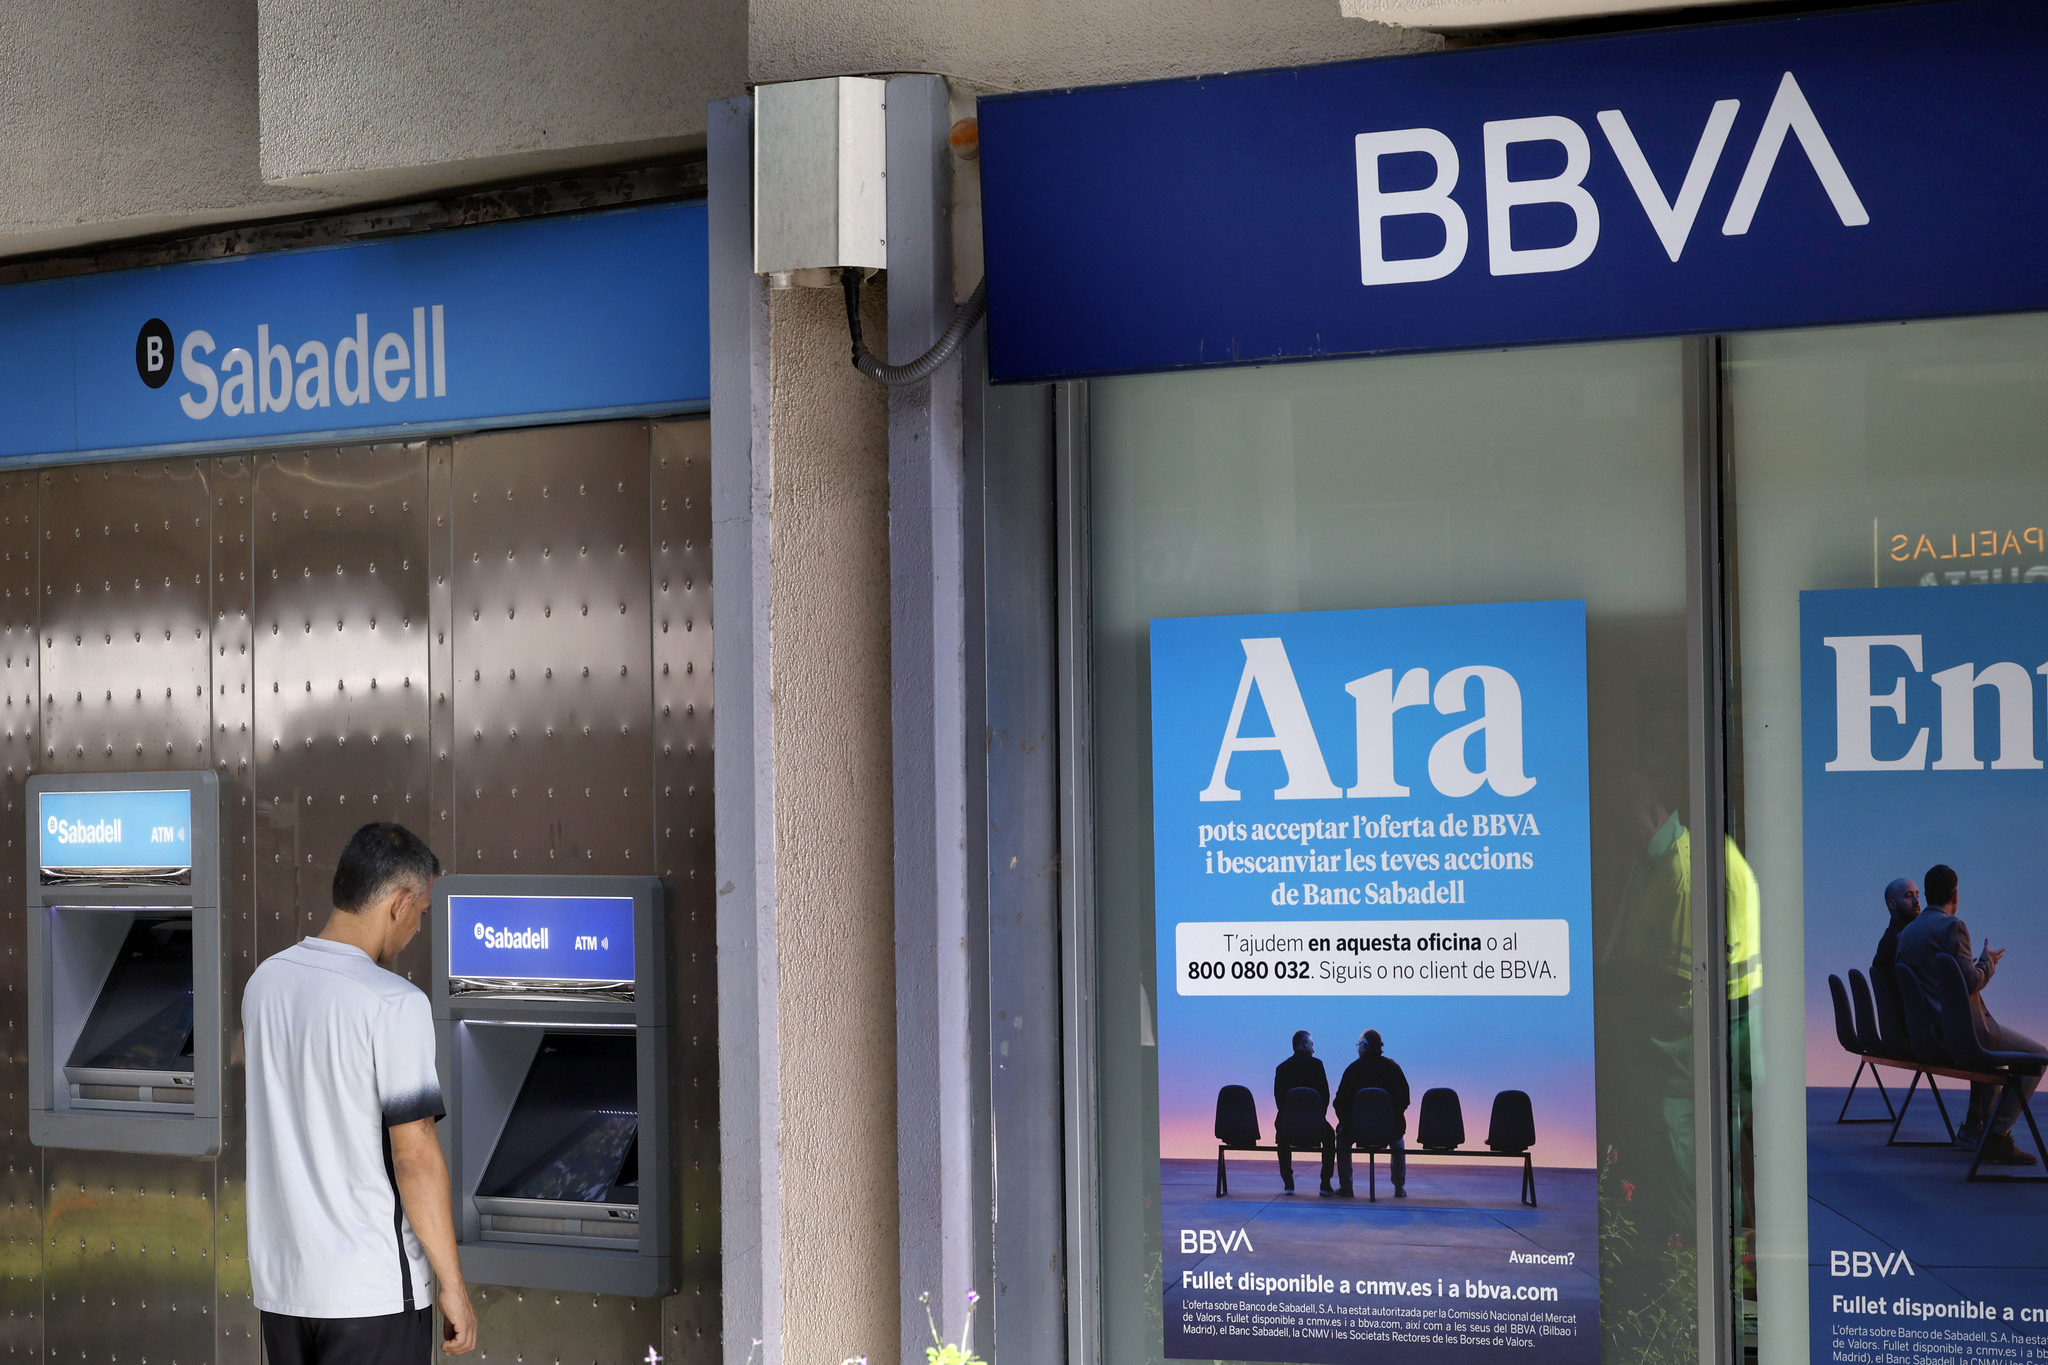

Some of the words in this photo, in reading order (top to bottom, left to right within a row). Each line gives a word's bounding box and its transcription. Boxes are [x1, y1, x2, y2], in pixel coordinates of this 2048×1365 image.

[1355, 71, 1869, 286] BBVA
[180, 305, 446, 420] Sabadell
[1824, 634, 2048, 772] En
[1200, 637, 1537, 802] Ara
[58, 819, 121, 843] Sabadell
[151, 827, 174, 842] ATM
[1199, 821, 1247, 847] pots
[1252, 819, 1349, 845] acceptar
[1439, 814, 1468, 837] de
[1472, 814, 1540, 836] BBVA
[1206, 851, 1213, 873] i
[1217, 849, 1341, 873] bescanviar
[1345, 848, 1376, 871] les
[1381, 851, 1440, 871] teves
[1444, 846, 1533, 870] accions
[1271, 882, 1299, 905] de
[1303, 884, 1361, 905] Banc
[1365, 880, 1465, 904] Sabadell
[485, 927, 548, 949] Sabadell
[575, 936, 597, 950] ATM
[1309, 938, 1330, 951] en
[1337, 934, 1410, 955] aquesta
[1417, 933, 1481, 951] oficina
[1487, 937, 1497, 950] o
[1502, 932, 1518, 951] al
[1189, 962, 1225, 979] 800
[1232, 961, 1268, 979] 080
[1275, 961, 1315, 980] 032.
[1320, 961, 1371, 983] Siguis
[1377, 966, 1387, 979] o
[1394, 966, 1414, 979] no
[1420, 961, 1467, 979] client
[1473, 961, 1494, 979] de
[1501, 961, 1556, 978] BBVA.
[1181, 1228, 1253, 1254] BBVA
[1509, 1250, 1575, 1265] Avancem?
[1831, 1250, 1915, 1278] BBVA
[1183, 1271, 1233, 1289] Fullet
[1238, 1272, 1334, 1295] disponible
[1340, 1280, 1350, 1293] a
[1356, 1281, 1432, 1296] cnmv.es
[1438, 1279, 1442, 1296] i
[1449, 1284, 1459, 1297] a
[1466, 1280, 1557, 1301] bbva.com
[1215, 1301, 1238, 1310] sobre
[1240, 1301, 1266, 1311] Banco
[1267, 1303, 1277, 1312] de
[1279, 1302, 1317, 1314] Sabadell,
[1319, 1304, 1335, 1314] S.A.
[1337, 1305, 1347, 1314] ha
[1349, 1306, 1370, 1315] estat
[1372, 1307, 1421, 1317] autoritzada
[1423, 1310, 1437, 1319] per
[1439, 1309, 1446, 1318] la
[1448, 1309, 1488, 1320] Comissió
[1490, 1311, 1528, 1321] Nacional
[1530, 1312, 1543, 1322] del
[1545, 1313, 1576, 1323] Mercat
[1833, 1295, 1886, 1314] Fullet
[1893, 1298, 1996, 1320] disponible
[1183, 1312, 1193, 1321] de
[1196, 1312, 1223, 1322] Valors.
[1227, 1314, 1249, 1323] Fullet
[1252, 1315, 1295, 1327] disponible
[1307, 1318, 1341, 1326] cnmv.es
[1359, 1318, 1402, 1329] bbva.com,
[1406, 1320, 1420, 1329] així
[1455, 1322, 1467, 1331] les
[1494, 1324, 1507, 1333] del
[1511, 1324, 1536, 1334] BBVA
[1539, 1325, 1571, 1336] (Bilbao
[1184, 1324, 1218, 1336] Madrid),
[1220, 1326, 1227, 1334] el
[1229, 1326, 1250, 1335] Banc
[1252, 1327, 1290, 1337] Sabadell,
[1293, 1328, 1299, 1337] la
[1302, 1329, 1329, 1338] CNMV
[1336, 1330, 1347, 1339] les
[1350, 1330, 1390, 1341] Societats
[1392, 1332, 1430, 1342] Rectores
[1433, 1334, 1443, 1343] de
[1446, 1334, 1458, 1344] les
[1460, 1335, 1490, 1345] Borses
[1493, 1336, 1503, 1346] de
[1506, 1337, 1535, 1347] Valors.
[1870, 1327, 1897, 1339] sobre
[1898, 1328, 1928, 1339] Banco
[1930, 1329, 1942, 1339] de
[1944, 1330, 1988, 1342] Sabadell,
[1991, 1332, 2010, 1343] S.A.
[2012, 1334, 2023, 1344] ha
[1833, 1338, 1844, 1348] de
[1848, 1339, 1881, 1350] Valors.
[1884, 1340, 1909, 1351] Fullet
[1913, 1342, 1963, 1354] disponible
[1976, 1347, 2016, 1357] cnmv.es
